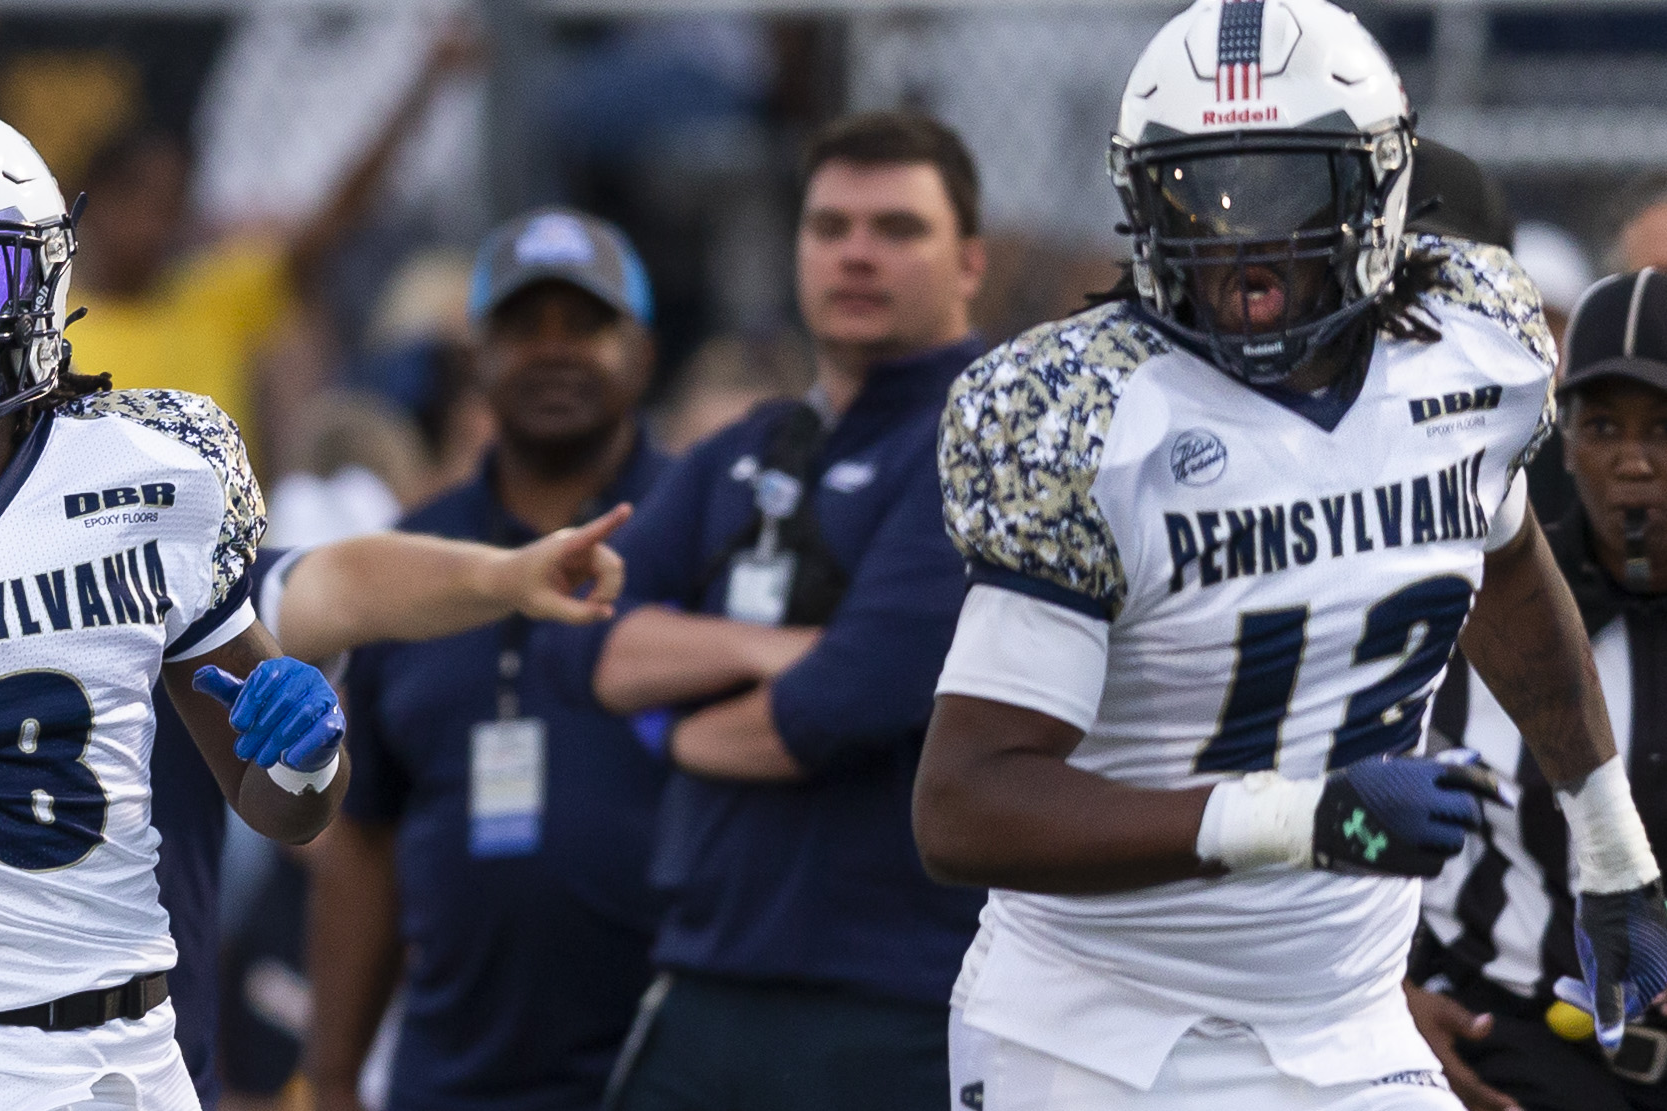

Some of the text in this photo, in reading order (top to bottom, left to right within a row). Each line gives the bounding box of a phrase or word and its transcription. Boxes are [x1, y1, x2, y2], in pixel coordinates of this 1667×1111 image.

[1203, 105, 1278, 125] Riddell
[64, 482, 176, 519] DBR
[84, 512, 159, 529] EPOXY FLOORS
[1189, 572, 1478, 775] 12
